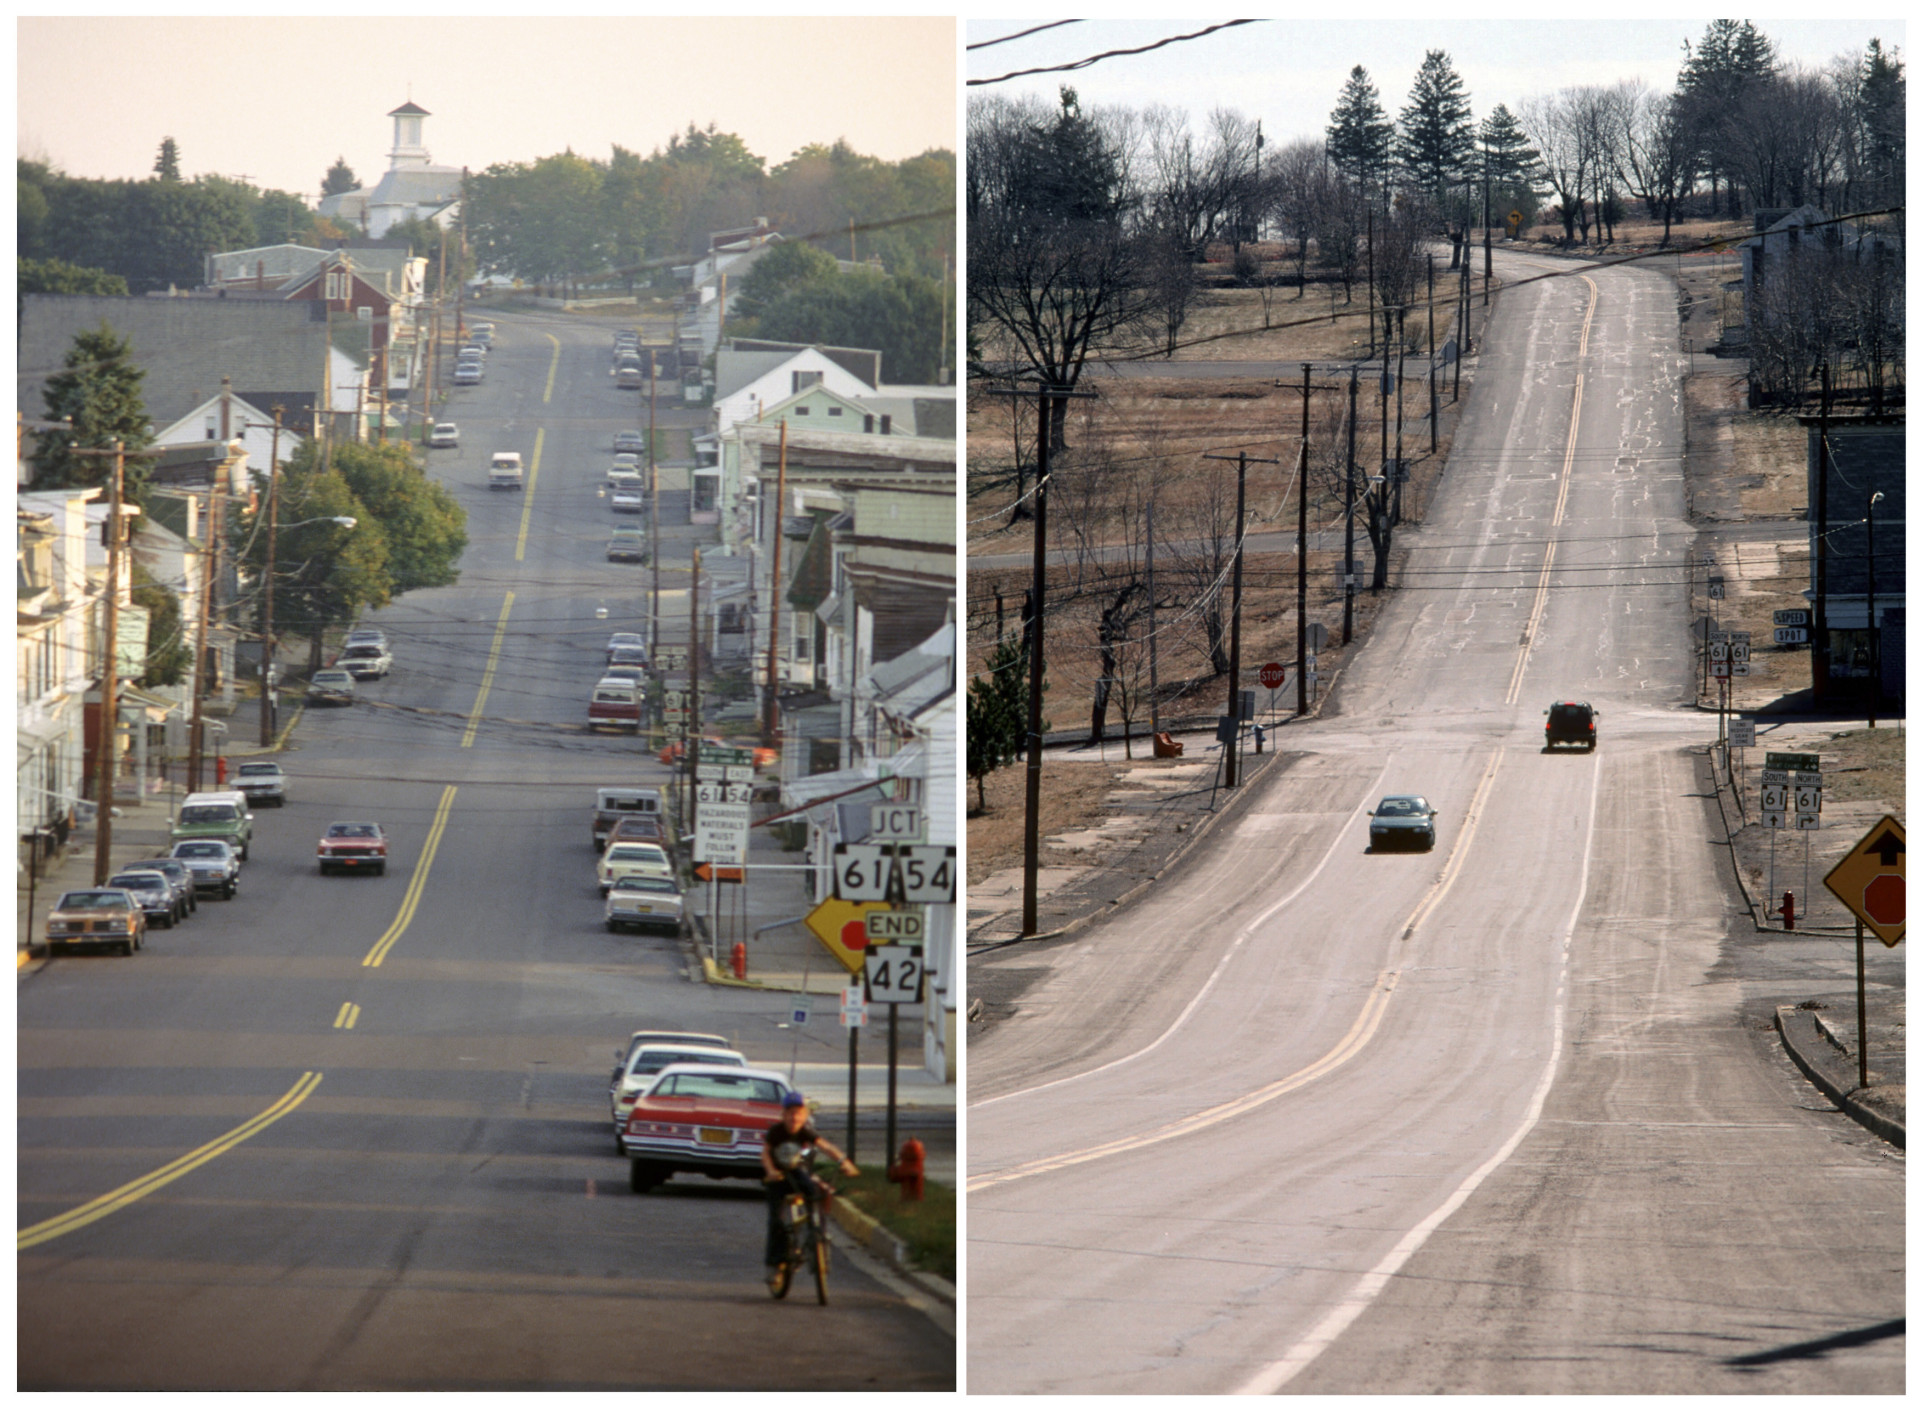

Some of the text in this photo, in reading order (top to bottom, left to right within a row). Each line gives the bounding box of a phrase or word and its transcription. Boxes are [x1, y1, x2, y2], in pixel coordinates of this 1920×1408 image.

[1713, 588, 1723, 597] 61
[1781, 612, 1803, 623] SPEED
[1710, 632, 1728, 640] SOUTH
[1779, 630, 1801, 641] SPOT
[1713, 647, 1726, 658] 61
[1734, 647, 1747, 658] 61
[1261, 670, 1283, 681] STOP
[1764, 772, 1787, 781] SOUTH
[1798, 774, 1821, 783] NORTH
[701, 787, 718, 801] 61
[729, 788, 748, 802] 54
[1765, 792, 1783, 806] 61
[1800, 793, 1817, 808] 61
[700, 808, 746, 818] HAZARDOUS
[701, 820, 744, 830] MATERIALS
[875, 811, 916, 833] JCT
[709, 832, 734, 841] MUST
[706, 843, 736, 852] FOLLOW
[844, 859, 882, 888] 61
[907, 860, 949, 890] 54
[869, 916, 920, 934] END
[872, 960, 916, 990] 42
